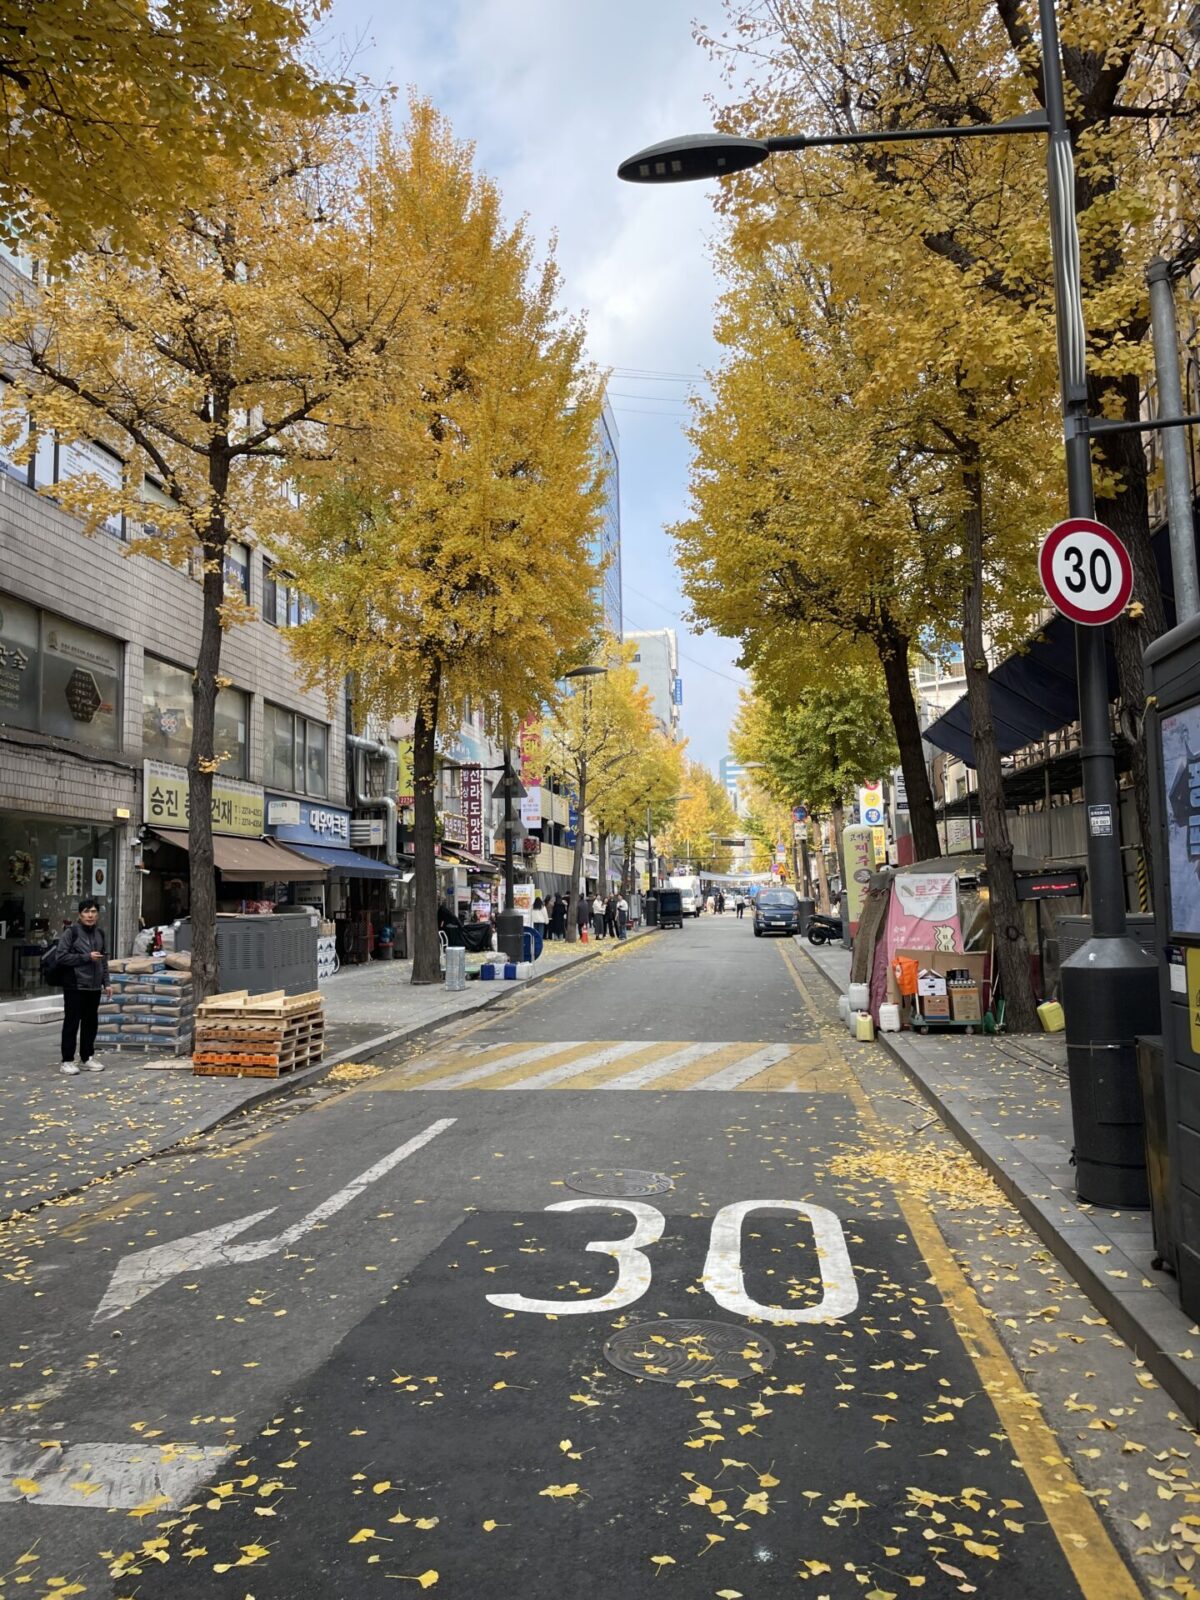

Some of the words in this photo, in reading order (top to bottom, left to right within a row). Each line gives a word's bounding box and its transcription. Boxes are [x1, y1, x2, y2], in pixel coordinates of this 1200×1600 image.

[1064, 546, 1112, 595] 30
[150, 785, 179, 817] 승진
[310, 810, 348, 838] 대우아크릴
[915, 885, 953, 897] 토스트
[484, 1199, 860, 1323] 30
